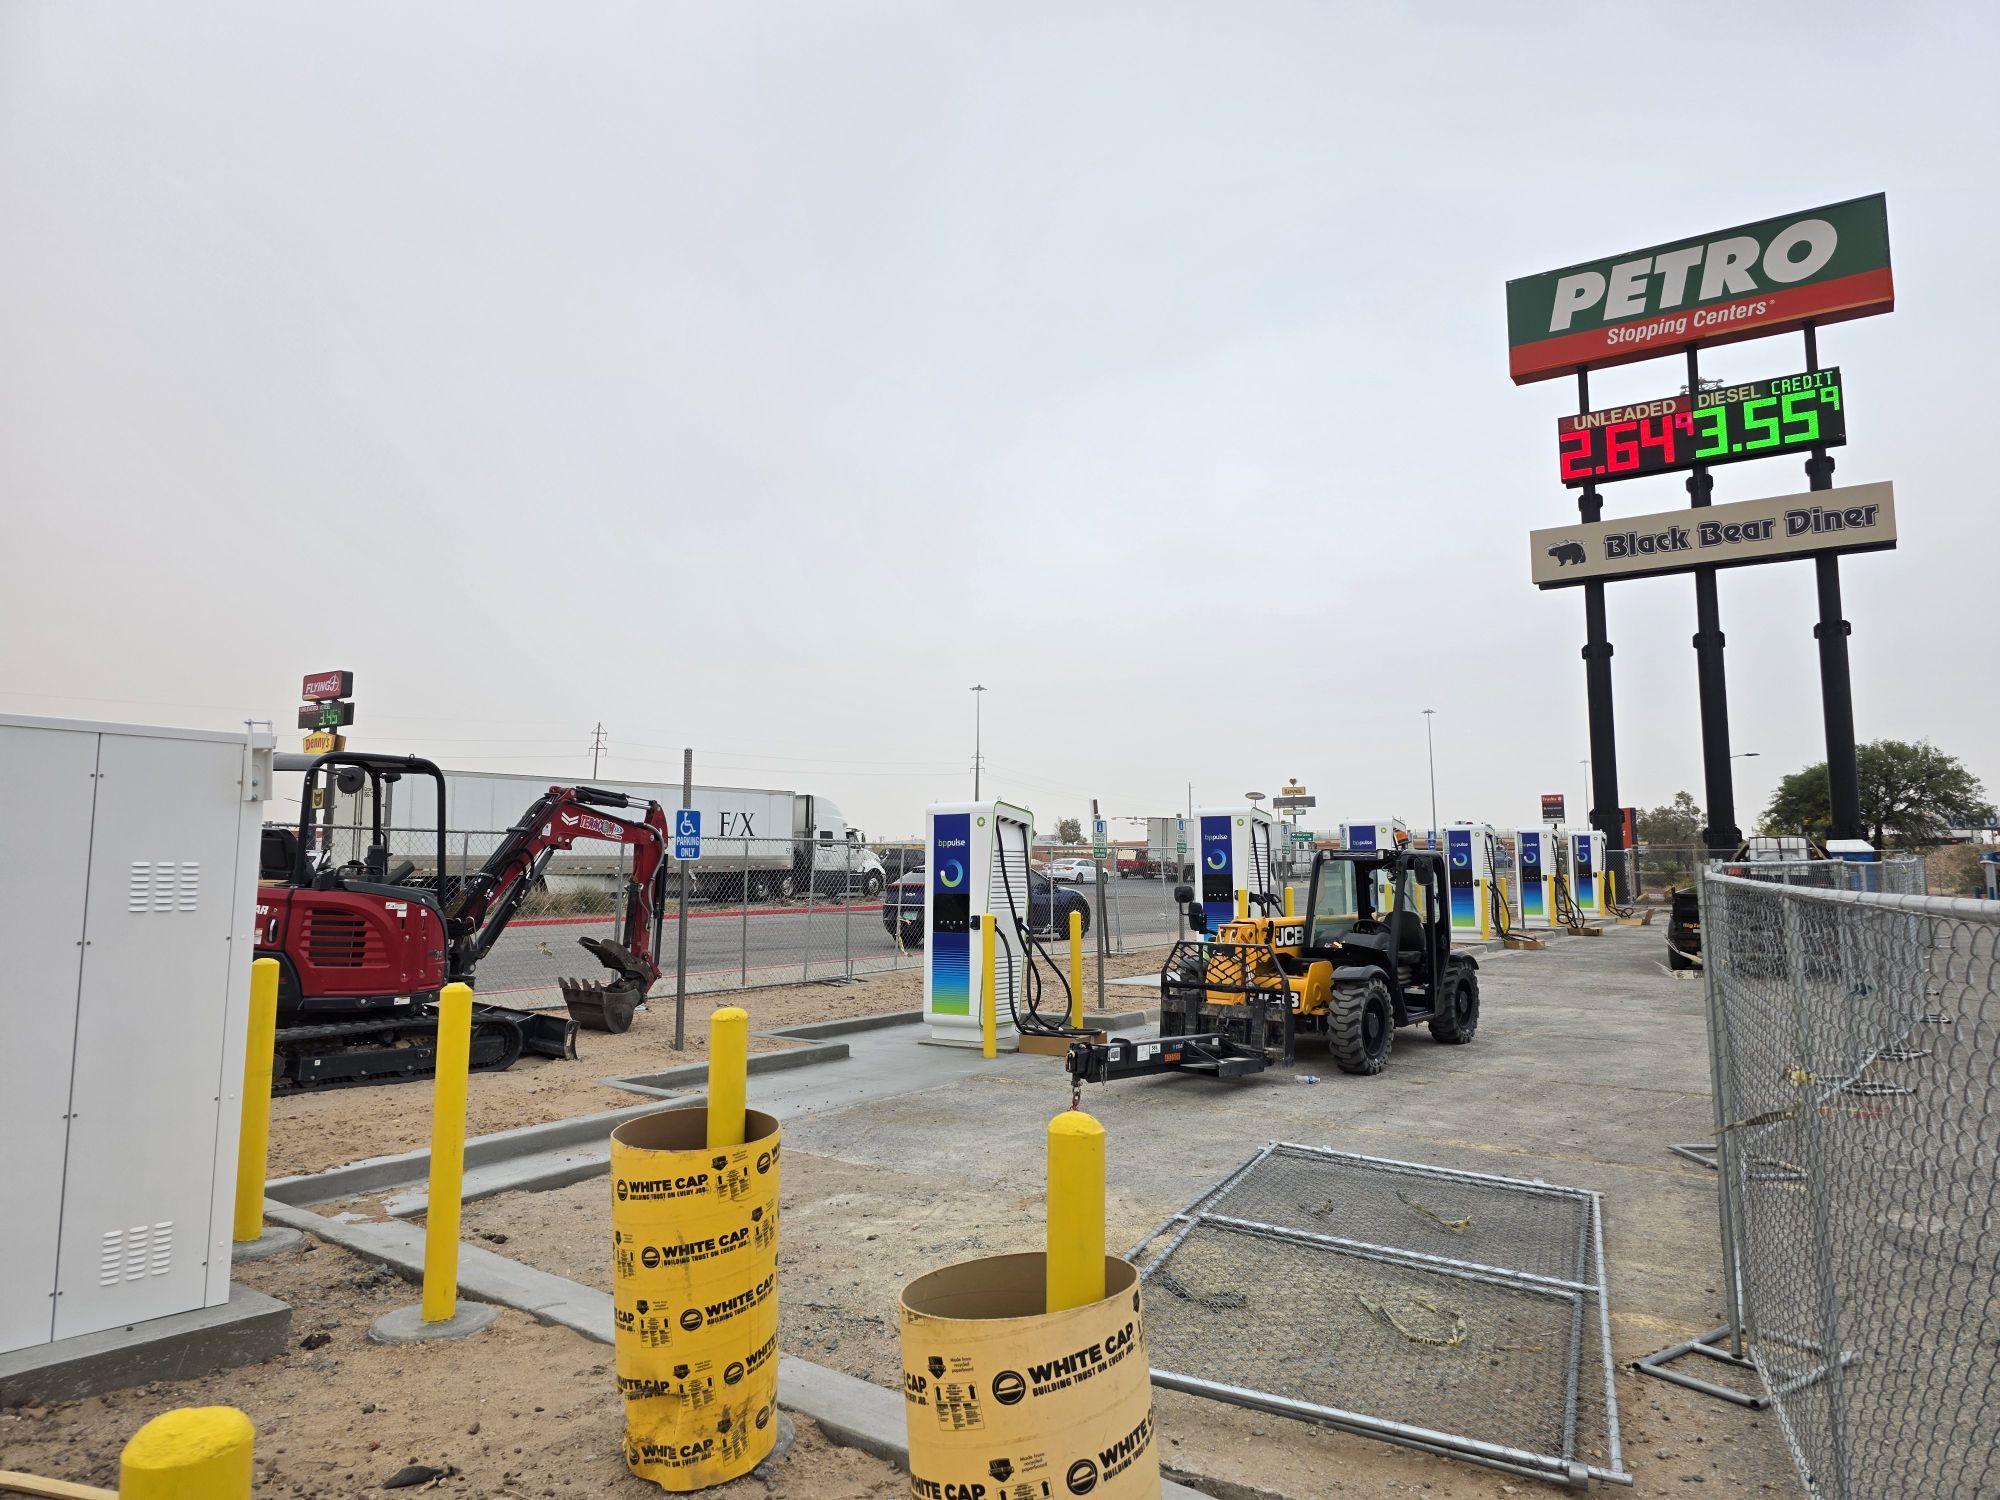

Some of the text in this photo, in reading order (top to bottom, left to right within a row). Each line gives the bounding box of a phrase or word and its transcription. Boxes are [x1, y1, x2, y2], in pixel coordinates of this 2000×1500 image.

[1548, 218, 1838, 333] PETRO
[1606, 300, 1767, 346] Stopping Centers
[1771, 371, 1834, 395] CREDIT
[1697, 386, 1762, 409] DIESEL
[1573, 400, 1677, 432] UNLEADED
[1604, 503, 1880, 561] Black Bear Diner
[305, 736, 330, 750] Denny's
[719, 811, 755, 837] F/X
[676, 836, 700, 846] PARKING
[680, 847, 696, 857] ONLY
[1276, 926, 1304, 947] JCB
[629, 1179, 672, 1193] WHITE
[675, 1173, 708, 1189] CAP
[662, 1227, 750, 1258] WHITE CAP
[692, 1252, 710, 1262] TRUST
[705, 1273, 774, 1317] WHITE CAP
[618, 1310, 635, 1324] CAP
[745, 1334, 776, 1367] WHITE
[1027, 1322, 1134, 1384] WHITE CAP
[906, 1371, 927, 1394] CAP
[1032, 1377, 1072, 1397] BUILDING
[1073, 1366, 1097, 1384] TRUST
[1097, 1361, 1108, 1374] ON
[1108, 1349, 1125, 1367] EVERY
[680, 1438, 714, 1458] CAP
[1098, 1417, 1148, 1469] WHITE
[1102, 1456, 1132, 1482] BUILDING
[944, 1483, 986, 1500] CAP
